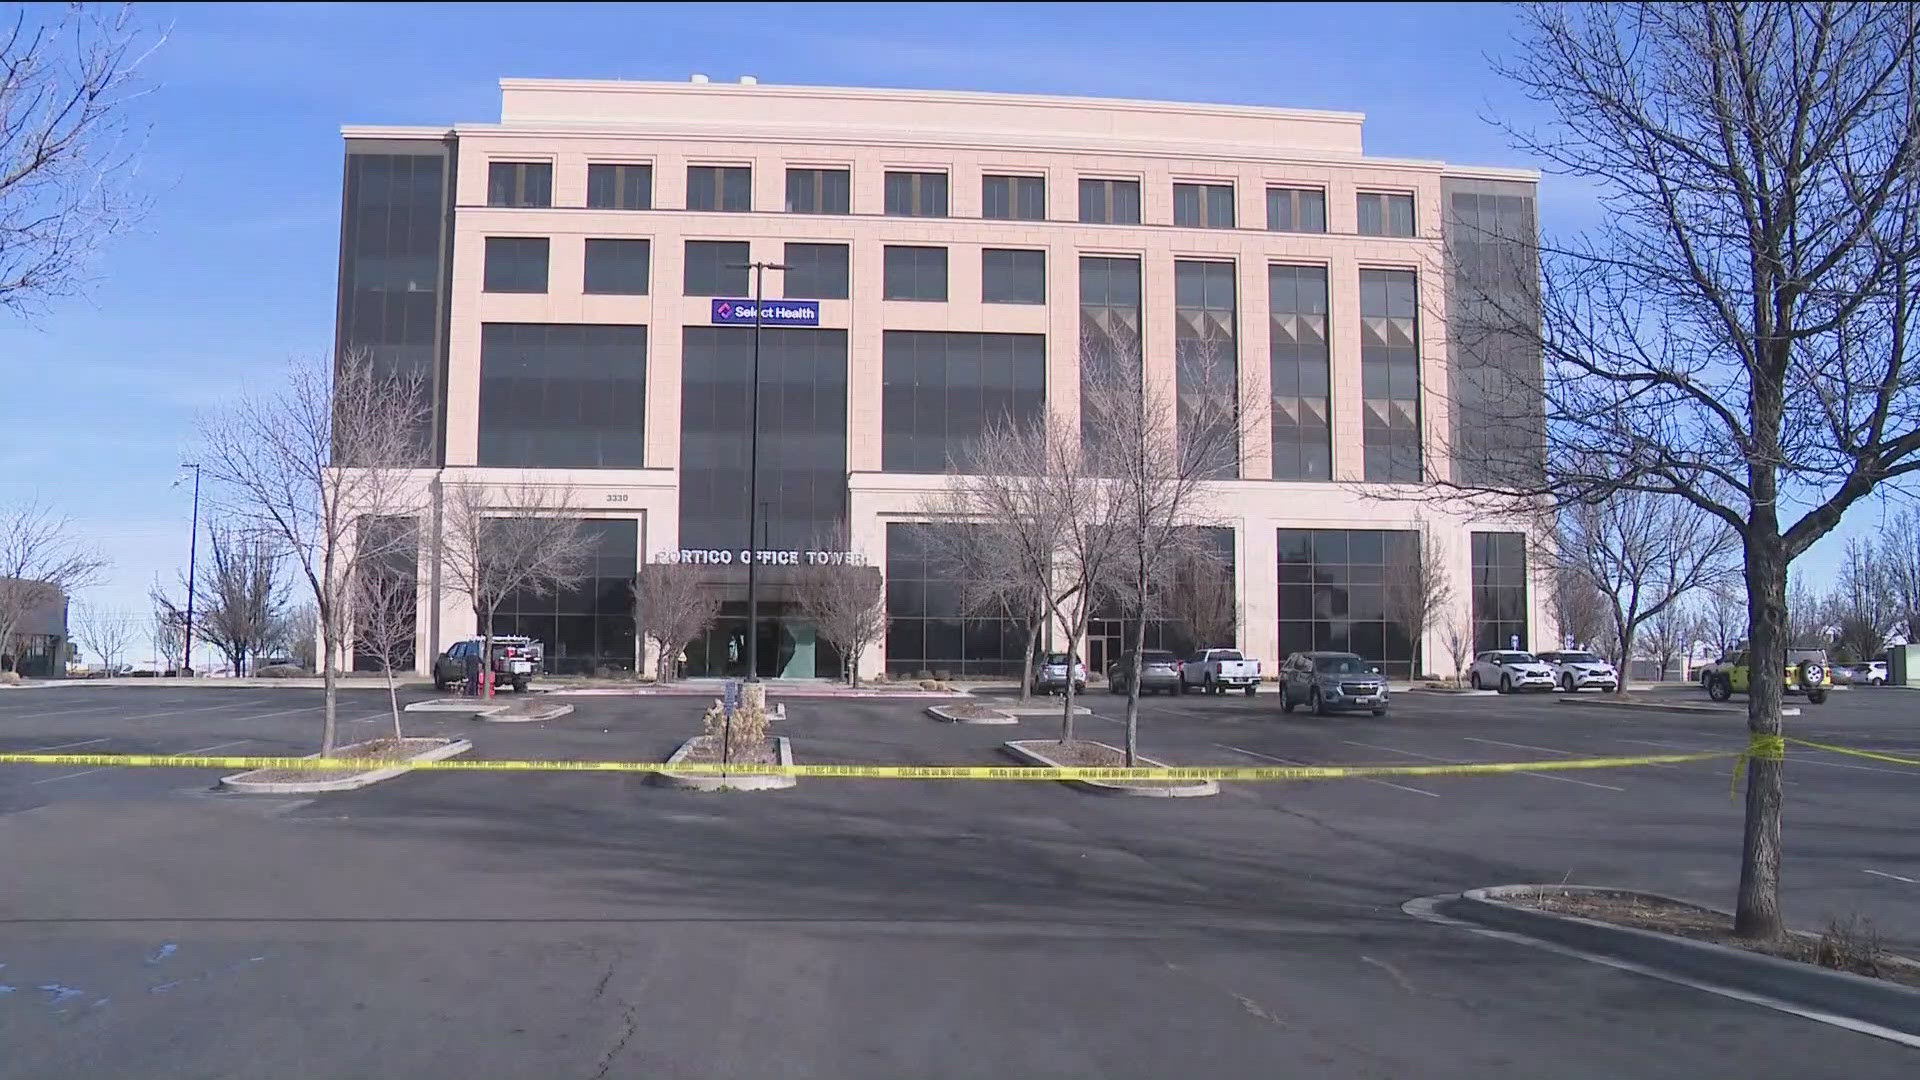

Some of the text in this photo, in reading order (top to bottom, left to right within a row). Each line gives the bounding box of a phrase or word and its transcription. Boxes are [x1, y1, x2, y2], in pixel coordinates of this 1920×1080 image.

[776, 307, 815, 319] Health
[606, 494, 629, 502] 3330
[659, 550, 867, 567] PORTICO OFFICE TOWER
